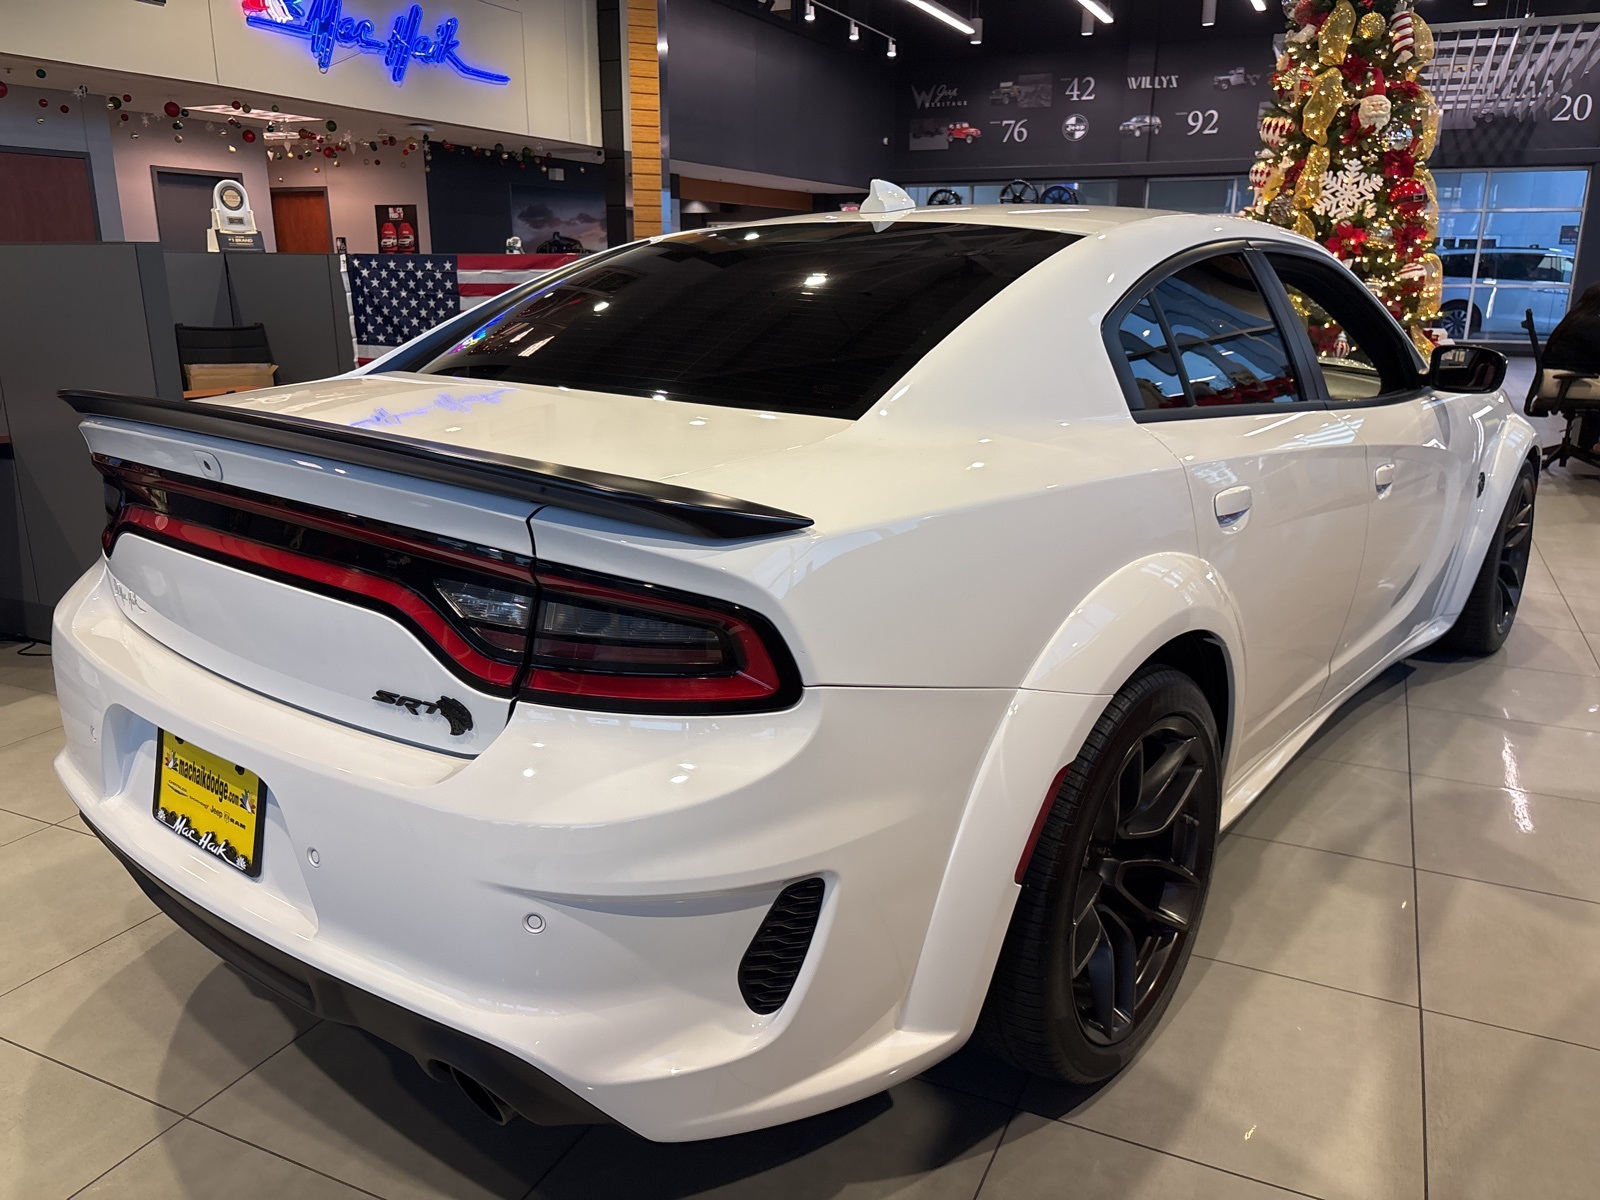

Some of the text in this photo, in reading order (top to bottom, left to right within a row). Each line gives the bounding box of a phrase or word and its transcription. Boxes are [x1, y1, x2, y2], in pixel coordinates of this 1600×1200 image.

[246, 0, 387, 69] Mac
[1127, 76, 1179, 90] WILLYS
[1552, 93, 1593, 122] 20
[371, 689, 440, 716] SRT
[179, 759, 239, 806] machaikdodge.com
[163, 816, 198, 843] Mac
